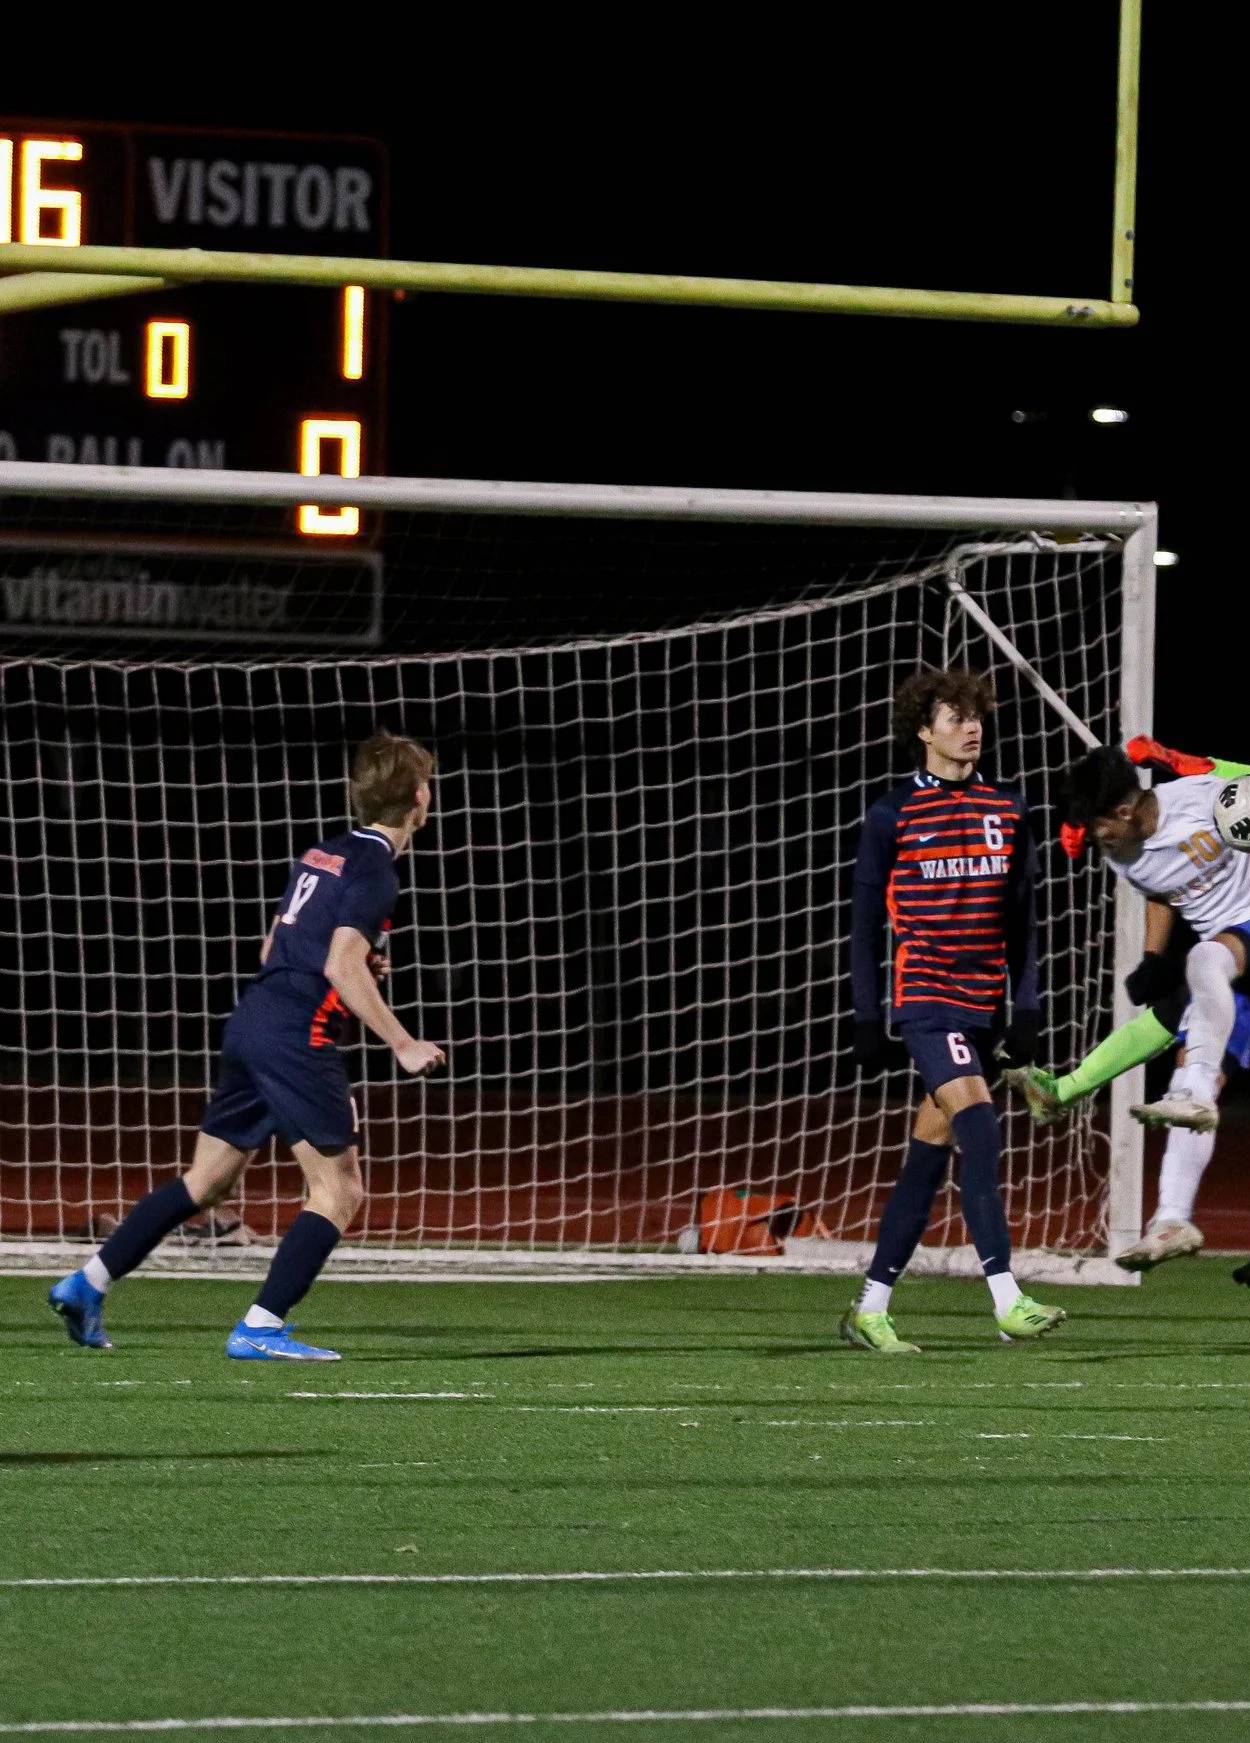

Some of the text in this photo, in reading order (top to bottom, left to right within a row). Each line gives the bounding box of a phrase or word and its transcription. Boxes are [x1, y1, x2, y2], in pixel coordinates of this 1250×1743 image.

[146, 155, 375, 233] VISITOR
[58, 327, 130, 385] TOL
[145, 321, 191, 399] 0
[342, 285, 365, 380] 1
[982, 814, 1004, 851] 6
[1178, 830, 1221, 869] 10
[946, 1031, 972, 1066] 6
